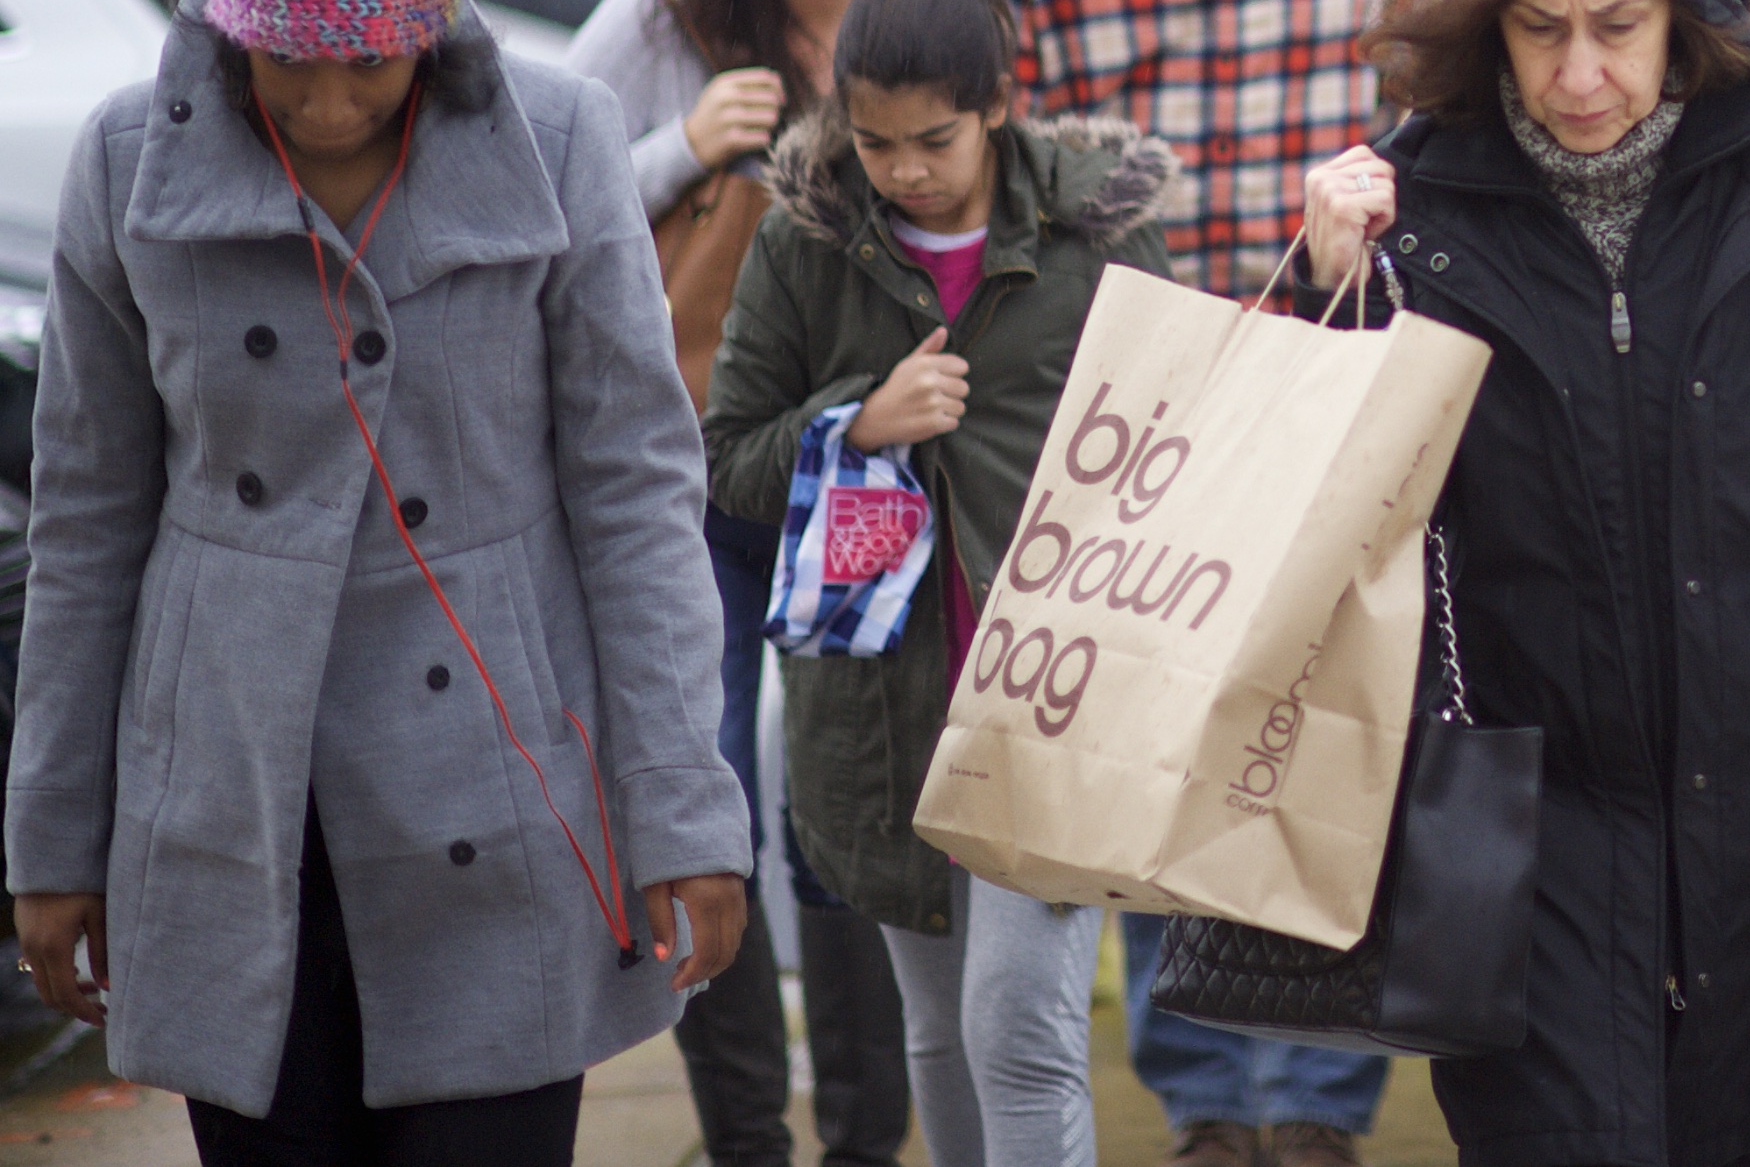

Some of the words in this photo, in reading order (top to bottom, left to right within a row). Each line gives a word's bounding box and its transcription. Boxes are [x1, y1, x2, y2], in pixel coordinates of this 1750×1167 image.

[830, 494, 923, 533] Bath
[1065, 383, 1191, 524] big
[1008, 490, 1233, 631] brown
[974, 589, 1097, 738] bag
